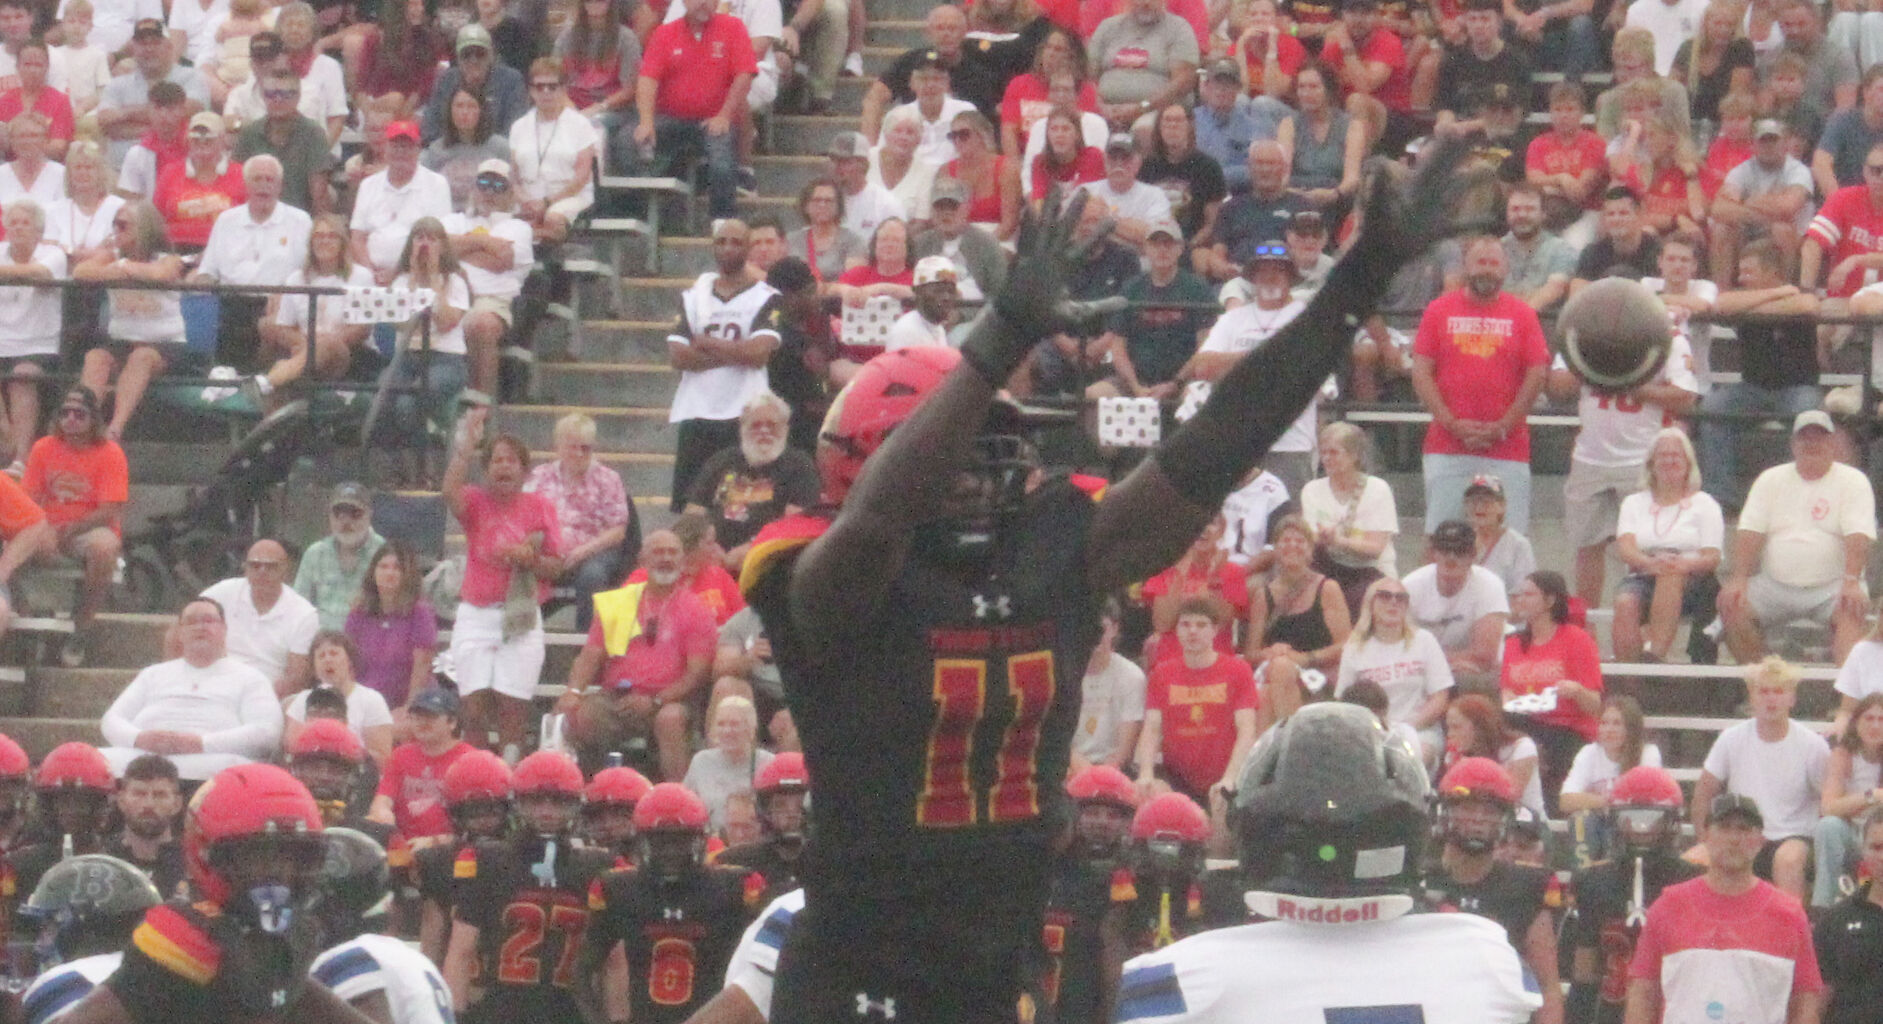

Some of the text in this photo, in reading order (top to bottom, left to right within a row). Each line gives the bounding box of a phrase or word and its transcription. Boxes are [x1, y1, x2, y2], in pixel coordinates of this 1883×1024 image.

[916, 650, 1056, 829] 11
[499, 901, 590, 988] 27
[1276, 898, 1379, 923] Riddell
